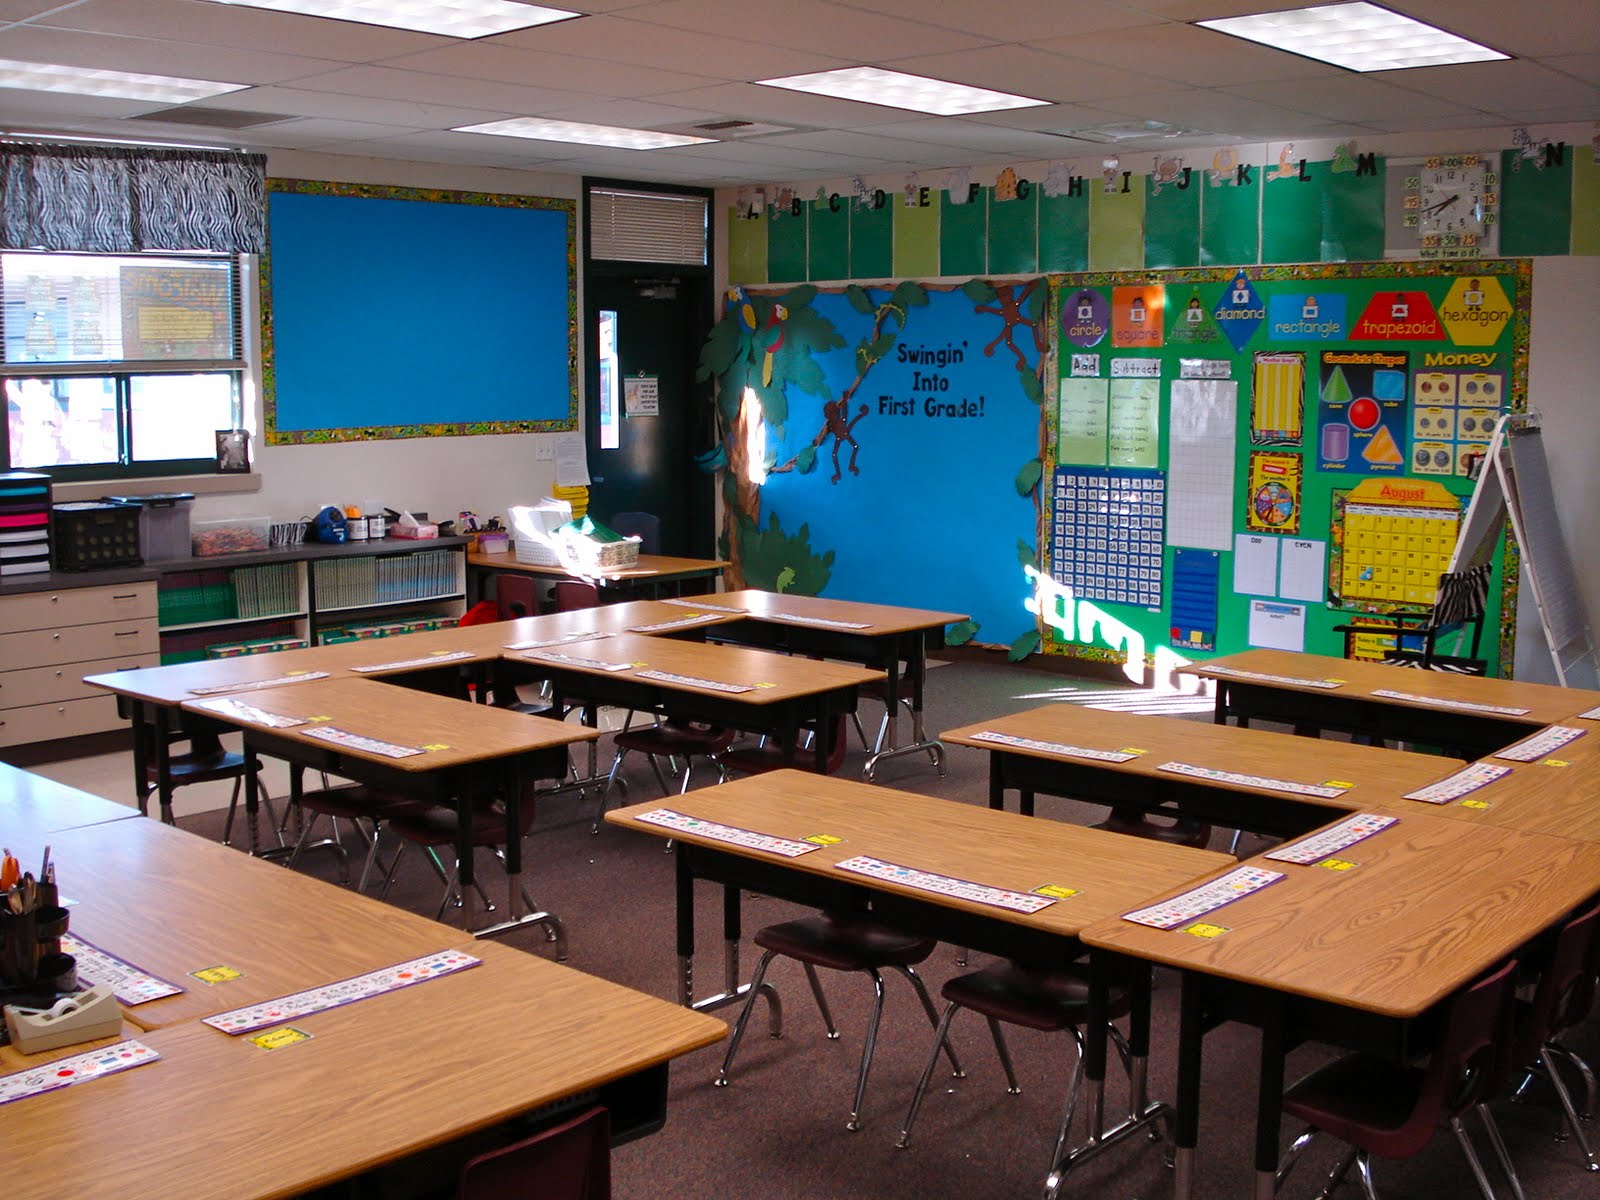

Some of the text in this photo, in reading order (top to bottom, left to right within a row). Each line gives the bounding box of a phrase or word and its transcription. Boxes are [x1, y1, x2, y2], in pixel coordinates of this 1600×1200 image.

[1356, 152, 1378, 176] M
[1546, 142, 1565, 168] N
[1177, 167, 1190, 190] J
[1237, 163, 1253, 187] K
[1299, 158, 1312, 182] L
[1016, 179, 1030, 200] G
[1068, 176, 1083, 198] H
[1122, 171, 1132, 194] I
[829, 192, 840, 212] C
[874, 190, 886, 210] D
[919, 187, 930, 208] E
[969, 183, 980, 204] F
[791, 197, 801, 217] B
[1420, 250, 1438, 258] What
[1442, 249, 1458, 257] time
[1469, 248, 1480, 256] it?
[1215, 306, 1266, 320] diamond
[1443, 307, 1509, 327] hexagon
[1069, 324, 1102, 337] circle
[1116, 329, 1159, 344] square
[1172, 326, 1217, 344] triangle
[1275, 320, 1341, 338] rectangle
[1362, 320, 1436, 338] trapezoid
[897, 340, 968, 368] Swingin'
[1322, 352, 1406, 368] Geometric Shapes
[1424, 352, 1498, 367] Money
[1073, 359, 1096, 372] Add
[1113, 362, 1158, 374] Subtract
[912, 372, 950, 392] Into
[878, 396, 985, 418] First Grade!
[1381, 486, 1425, 500] August
[1295, 541, 1312, 549] EVEN
